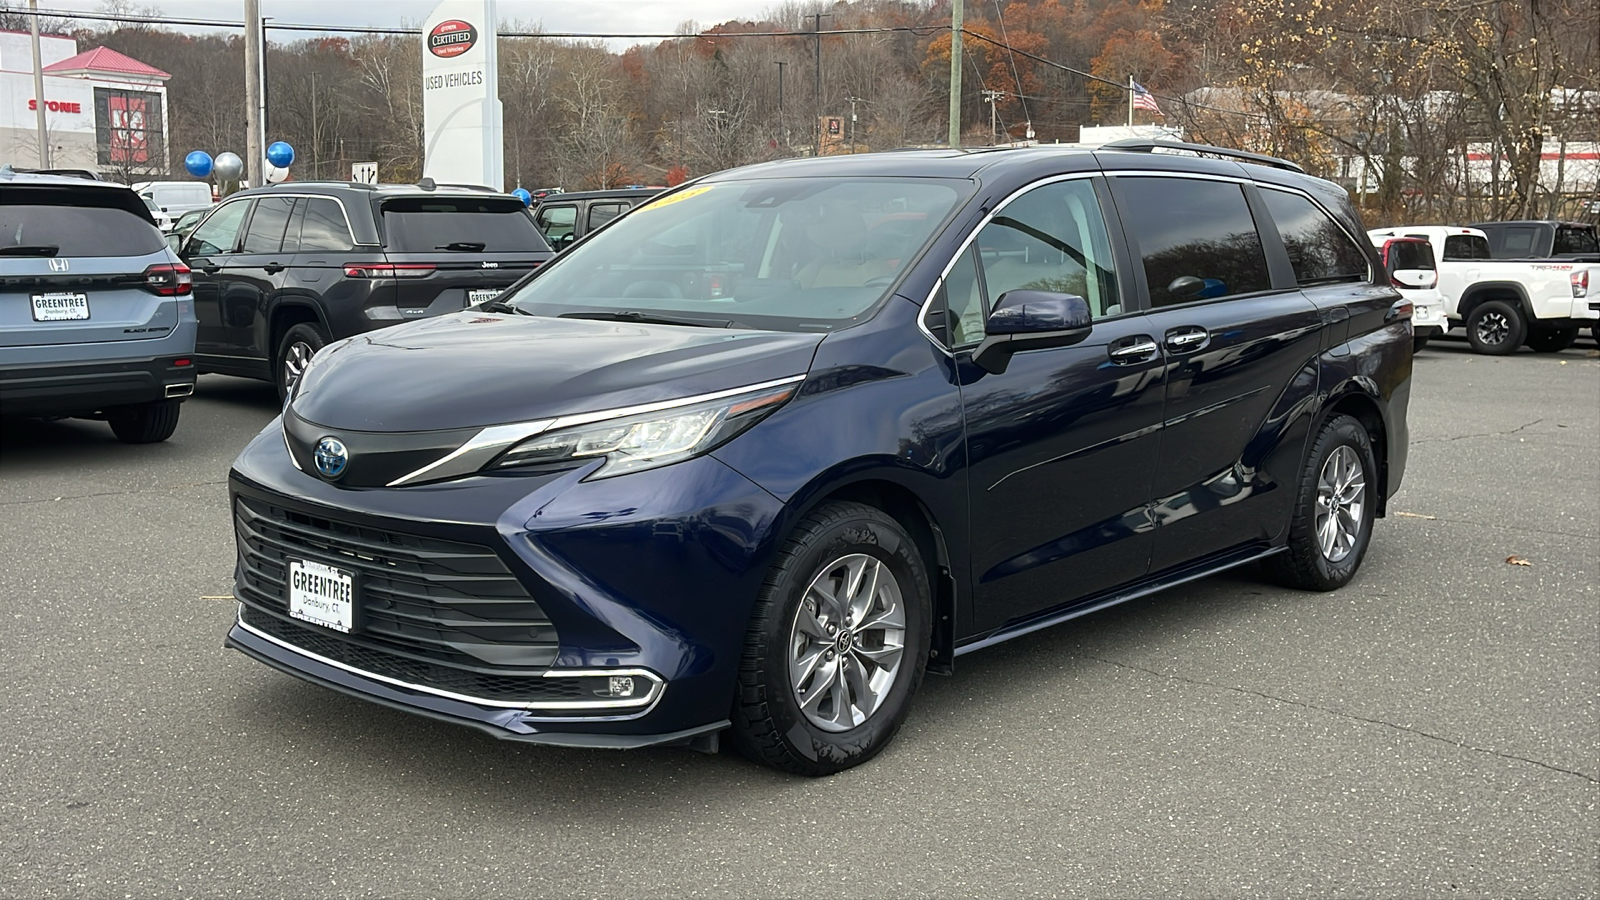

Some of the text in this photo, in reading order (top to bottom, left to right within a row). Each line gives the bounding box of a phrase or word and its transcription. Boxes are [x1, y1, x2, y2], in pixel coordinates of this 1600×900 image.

[432, 32, 471, 46] CERTIFIED
[425, 70, 483, 90] USED VEHICLES
[481, 261, 499, 269] Jeep
[35, 297, 85, 309] GREENTREE
[293, 570, 350, 604] GREENTREE
